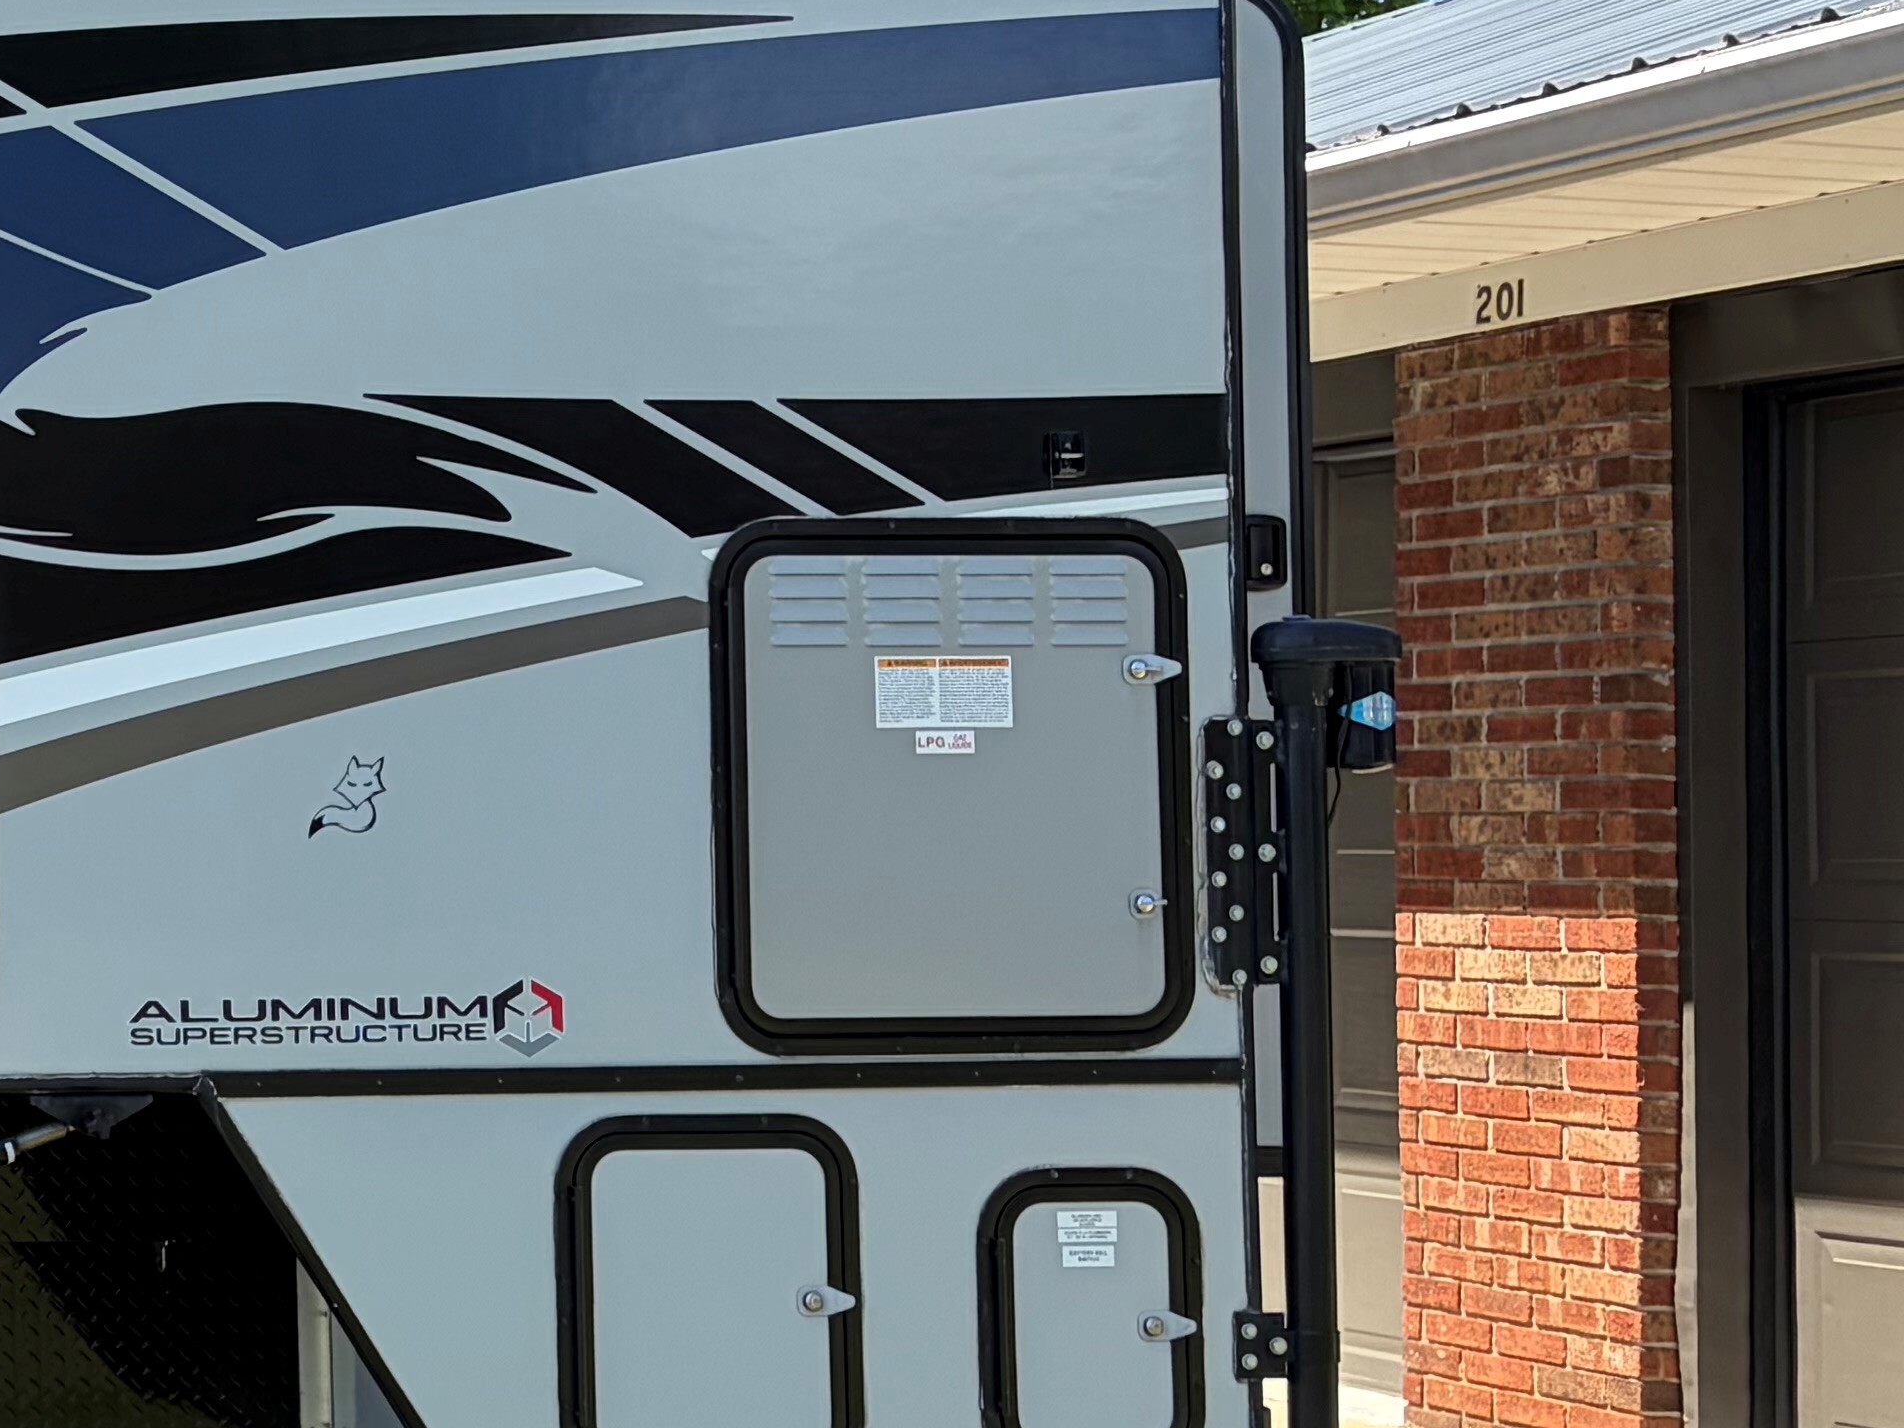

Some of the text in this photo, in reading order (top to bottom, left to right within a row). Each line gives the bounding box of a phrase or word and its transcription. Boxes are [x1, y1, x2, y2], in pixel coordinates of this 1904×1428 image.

[1476, 278, 1524, 324] 201
[918, 736, 945, 748] LPG
[129, 995, 489, 1023] ALUMINUM
[130, 1023, 488, 1046] SUPERSTRUCTURE
